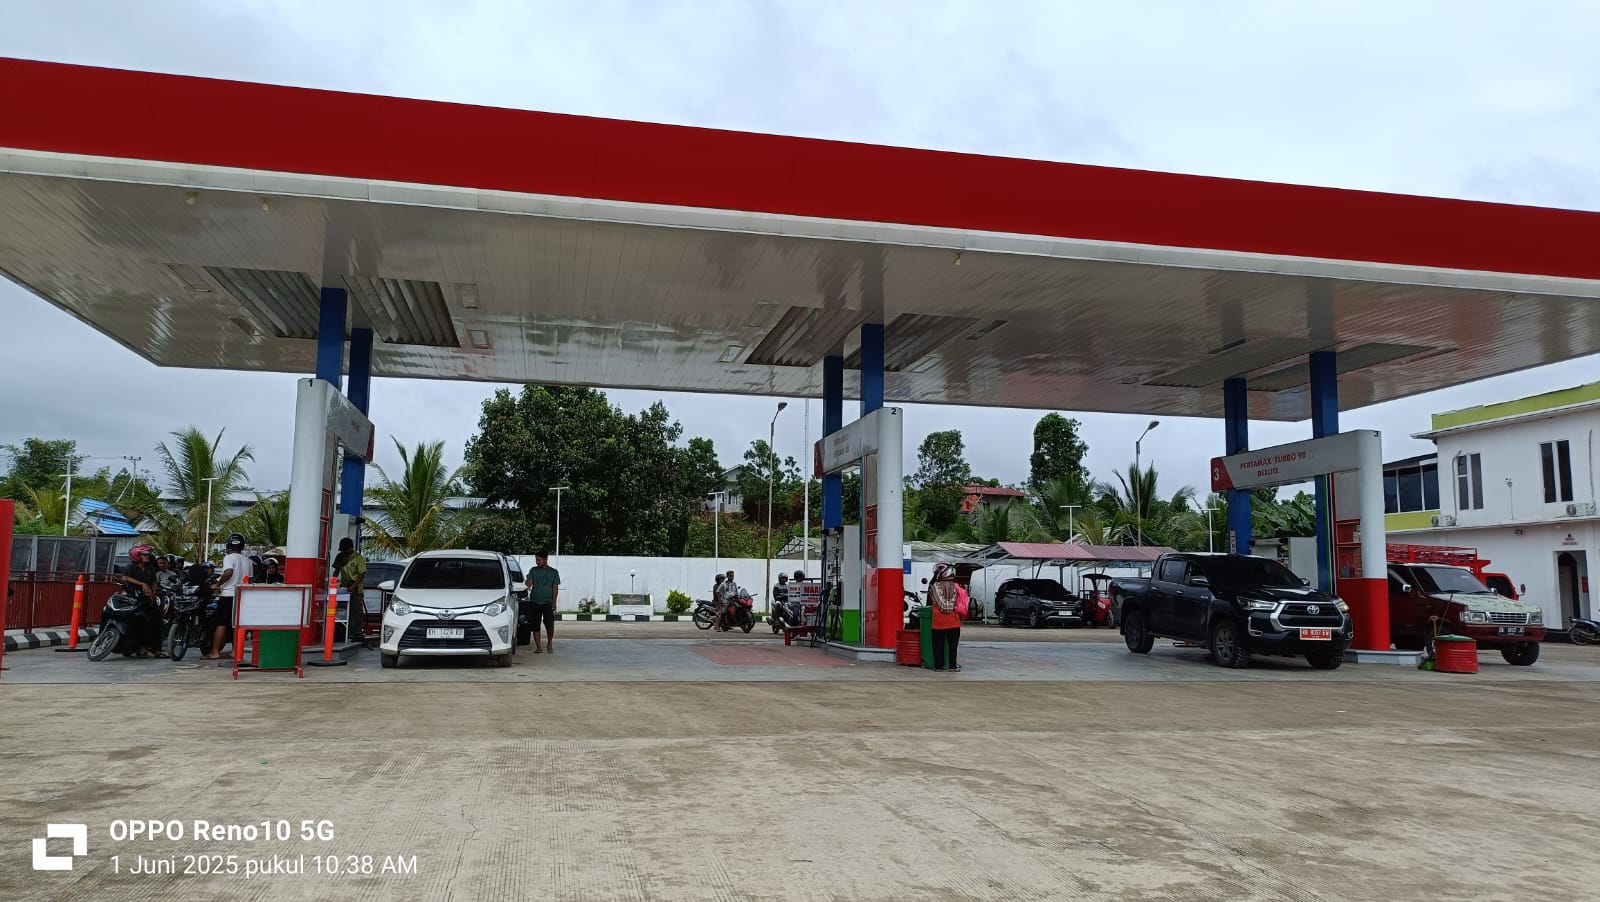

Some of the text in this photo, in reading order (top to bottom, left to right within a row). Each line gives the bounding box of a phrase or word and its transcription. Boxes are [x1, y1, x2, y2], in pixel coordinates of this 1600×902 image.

[308, 379, 313, 387] 1
[1240, 457, 1272, 469] PERTAMAX
[1274, 453, 1297, 464] TURBO
[1214, 467, 1220, 481] 3
[1257, 467, 1279, 477] DEXLITE
